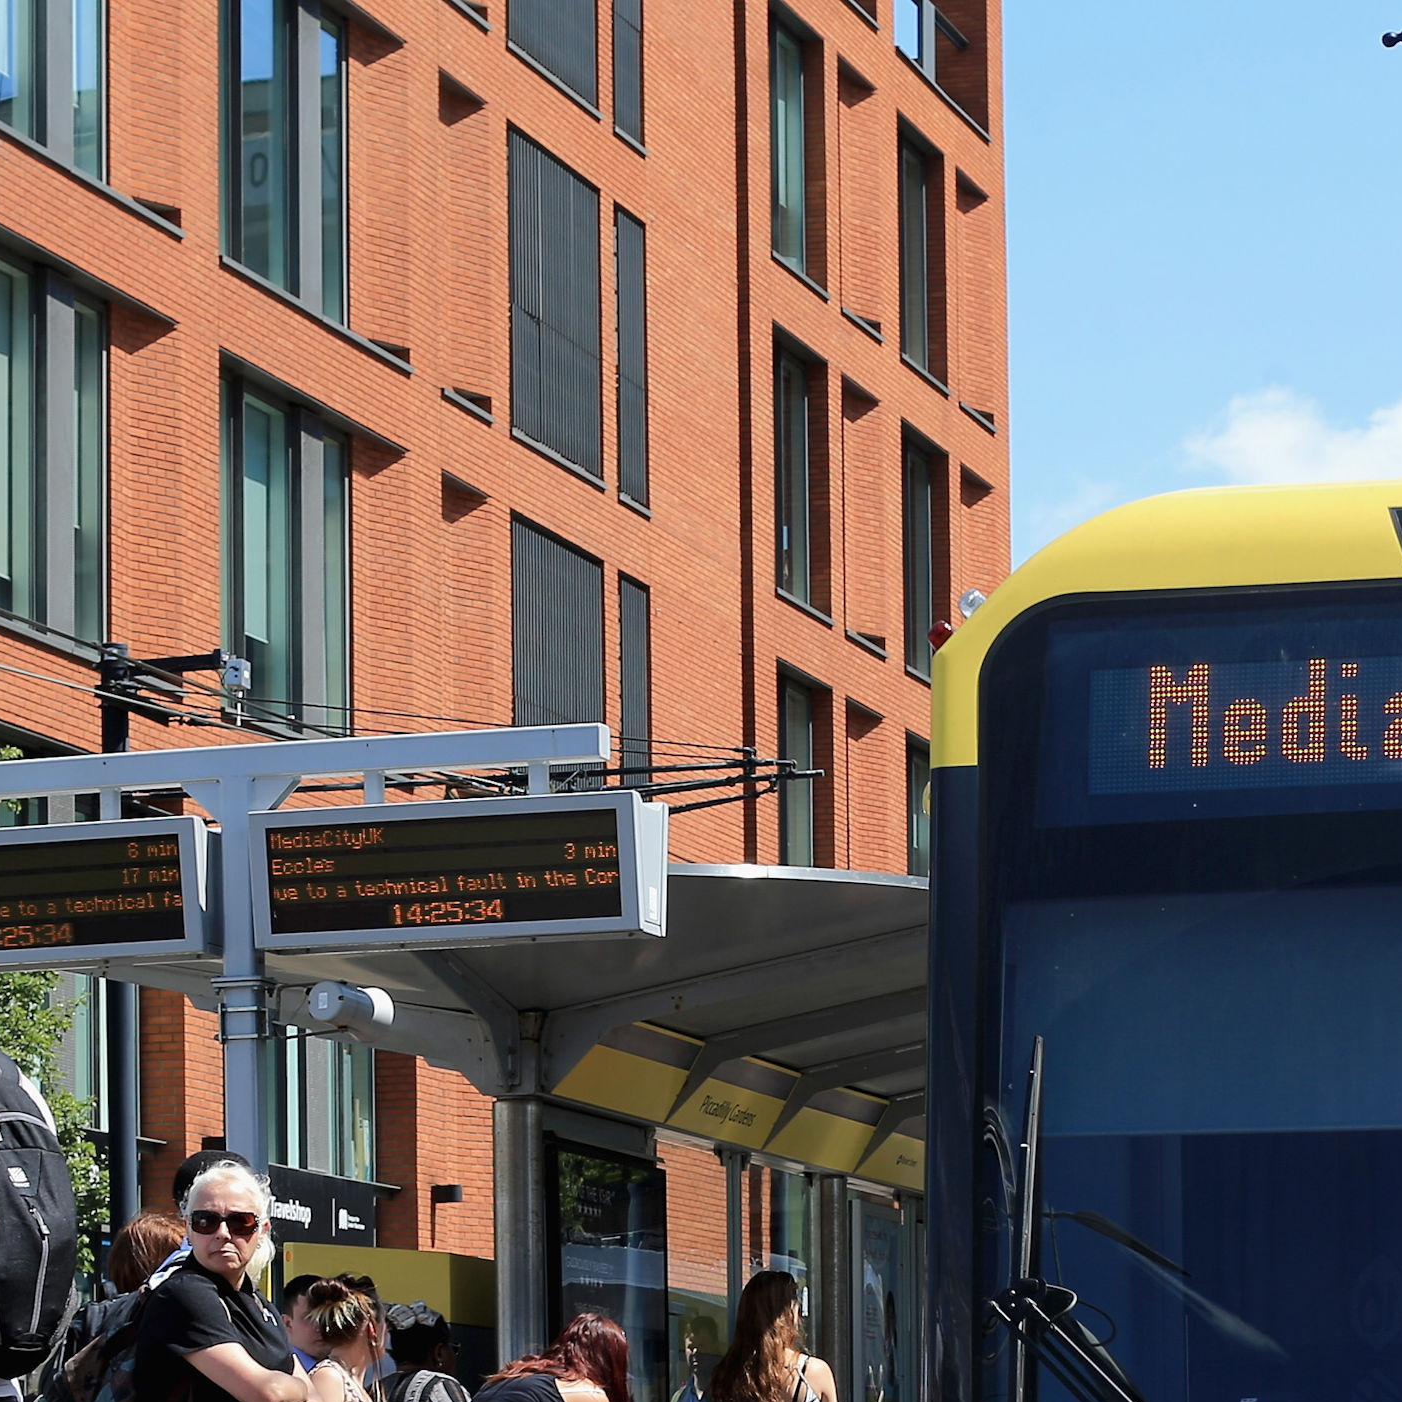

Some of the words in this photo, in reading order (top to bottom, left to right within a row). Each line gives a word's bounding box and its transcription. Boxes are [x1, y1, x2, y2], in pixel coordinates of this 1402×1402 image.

[270, 827, 384, 849] MediaCityUK
[147, 840, 178, 857] min
[564, 843, 576, 860] 3
[584, 841, 617, 859] min
[121, 867, 140, 884] 17
[149, 865, 180, 883] min
[271, 857, 335, 875] Eccles
[306, 882, 328, 900] to
[337, 884, 347, 898] a
[355, 876, 448, 898] technical
[456, 872, 506, 893] fault
[517, 870, 536, 890] in
[543, 870, 577, 887] the
[18, 900, 38, 916] to
[47, 903, 58, 914] a
[65, 892, 155, 913] technical
[392, 898, 504, 926] 14:25:34
